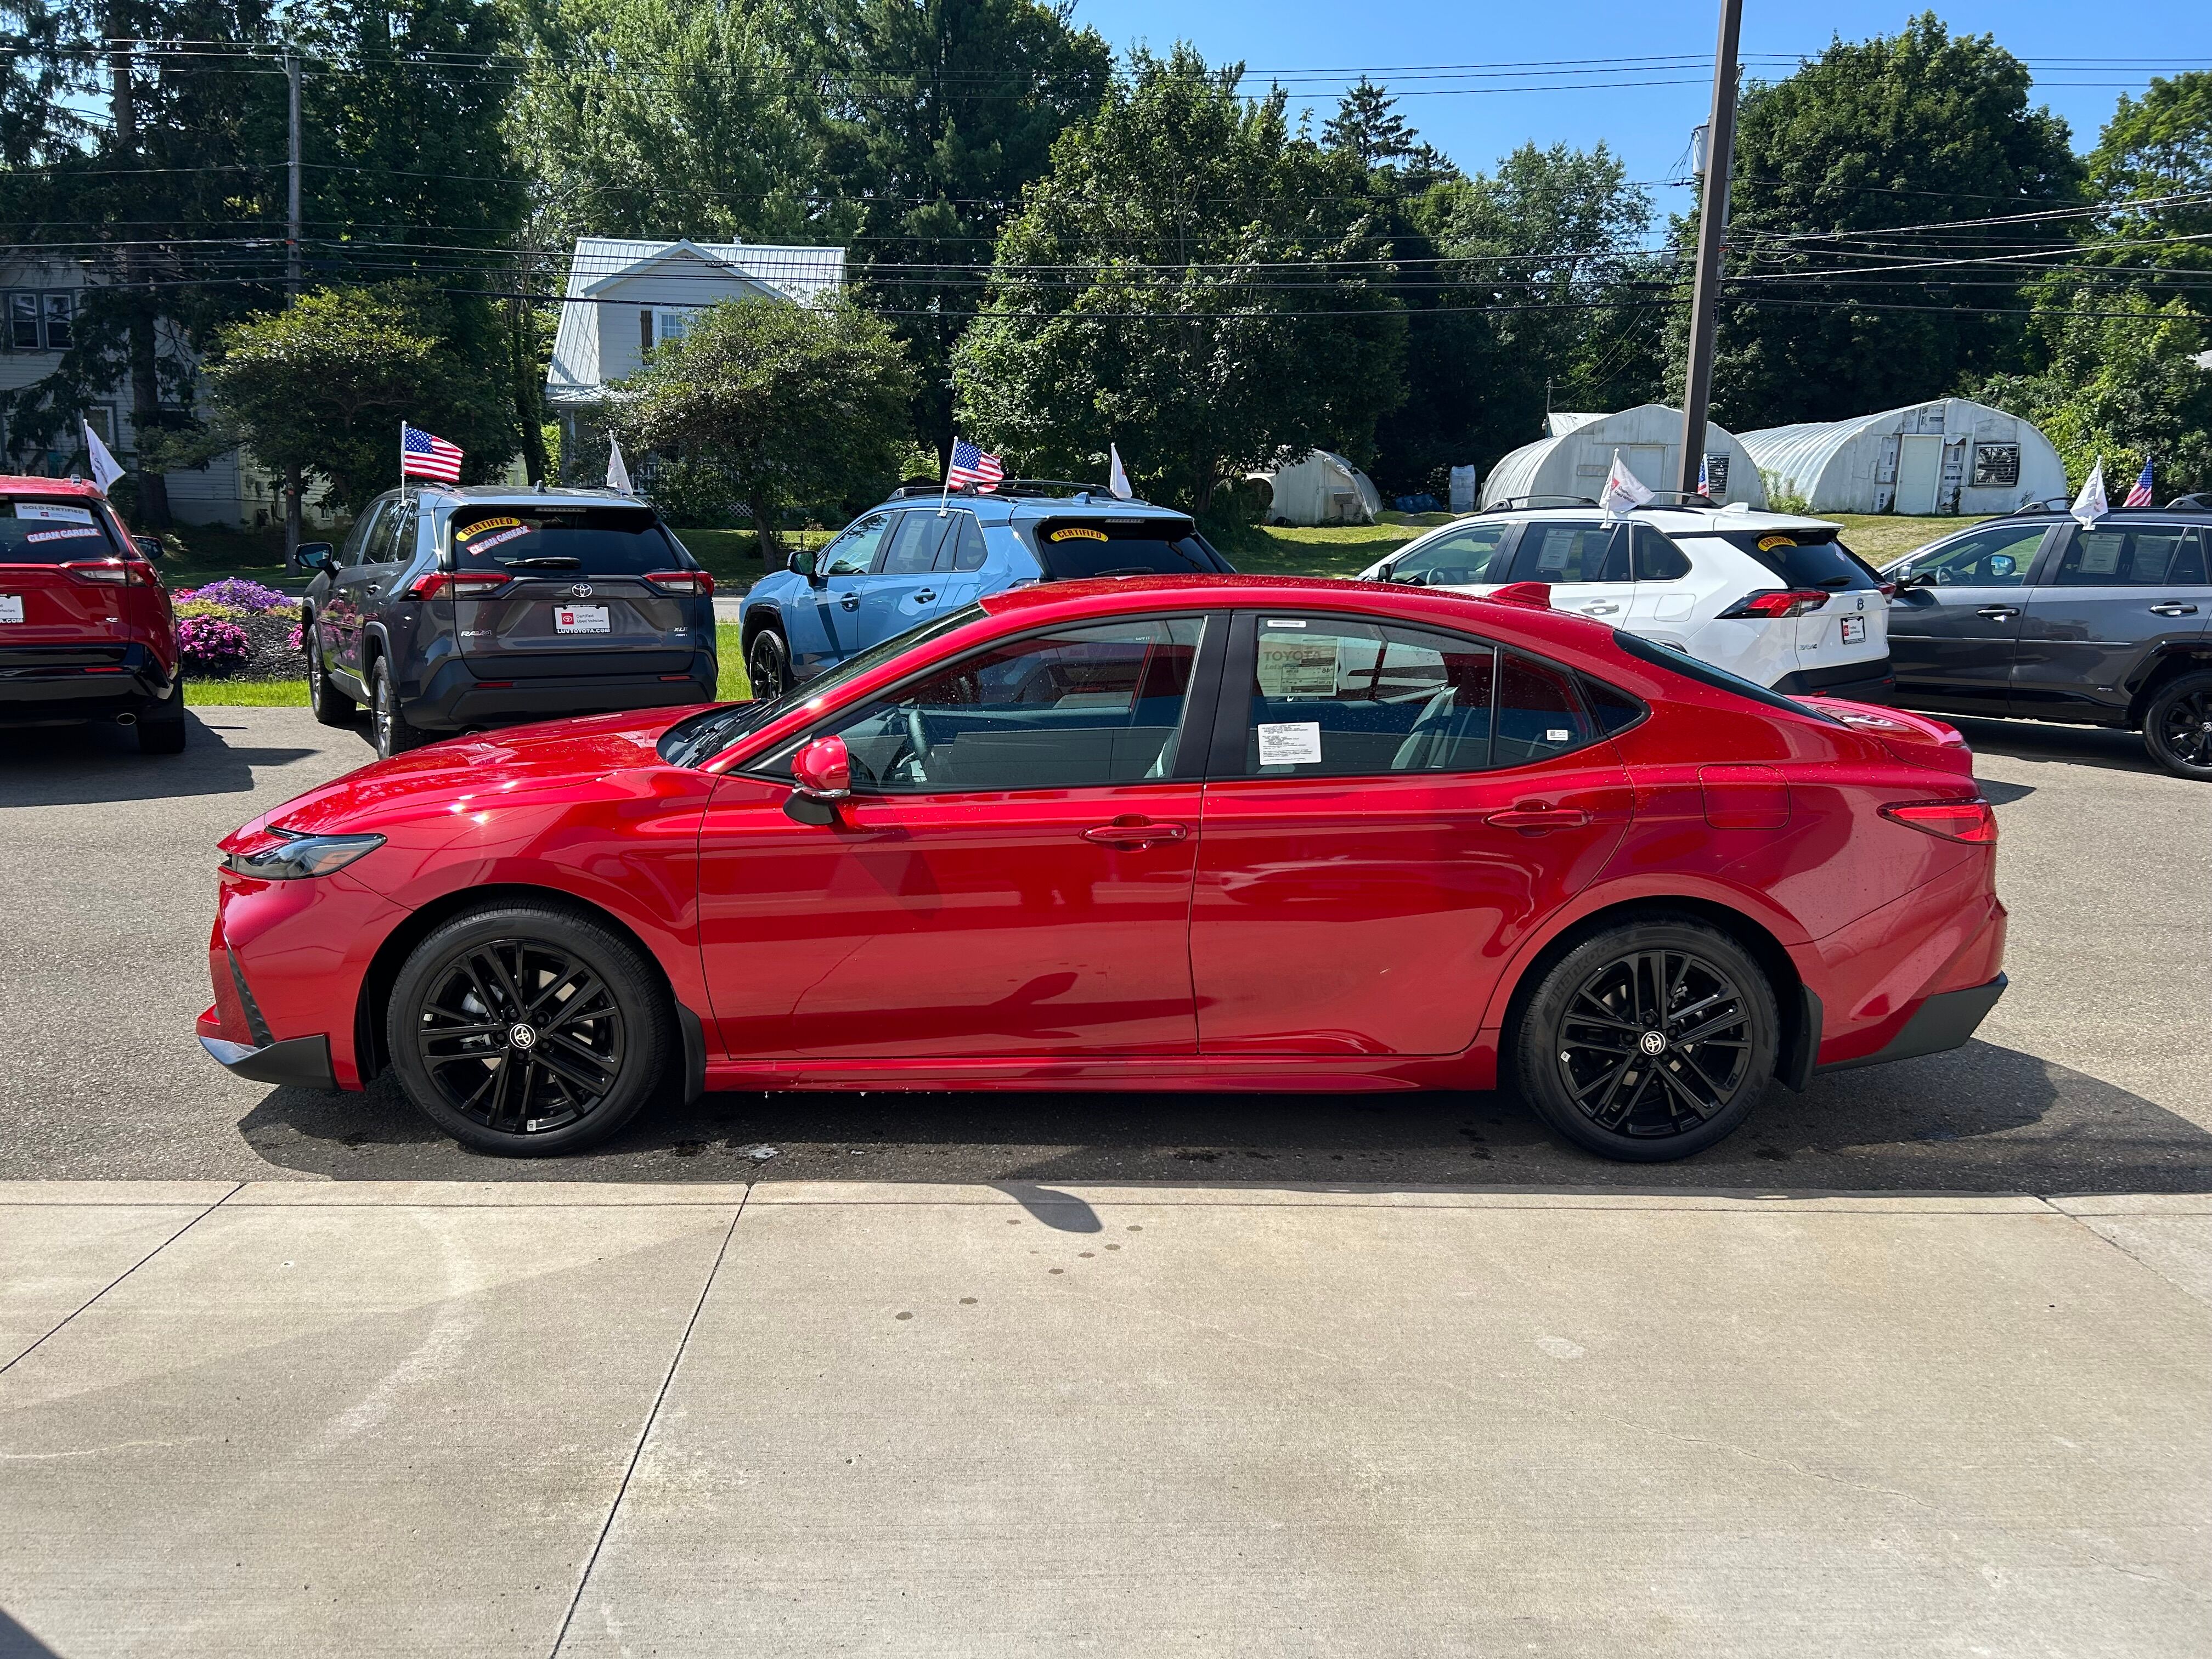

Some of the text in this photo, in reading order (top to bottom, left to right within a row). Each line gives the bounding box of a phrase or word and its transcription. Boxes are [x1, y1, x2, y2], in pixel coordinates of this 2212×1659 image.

[462, 518, 514, 536] CERTIFIED
[1057, 529, 1102, 538] CERTIFIED
[27, 528, 98, 543] CLEAN CARFAX
[469, 525, 527, 555] CLEAN CARFAX
[1760, 537, 1792, 548] CERTIFIED
